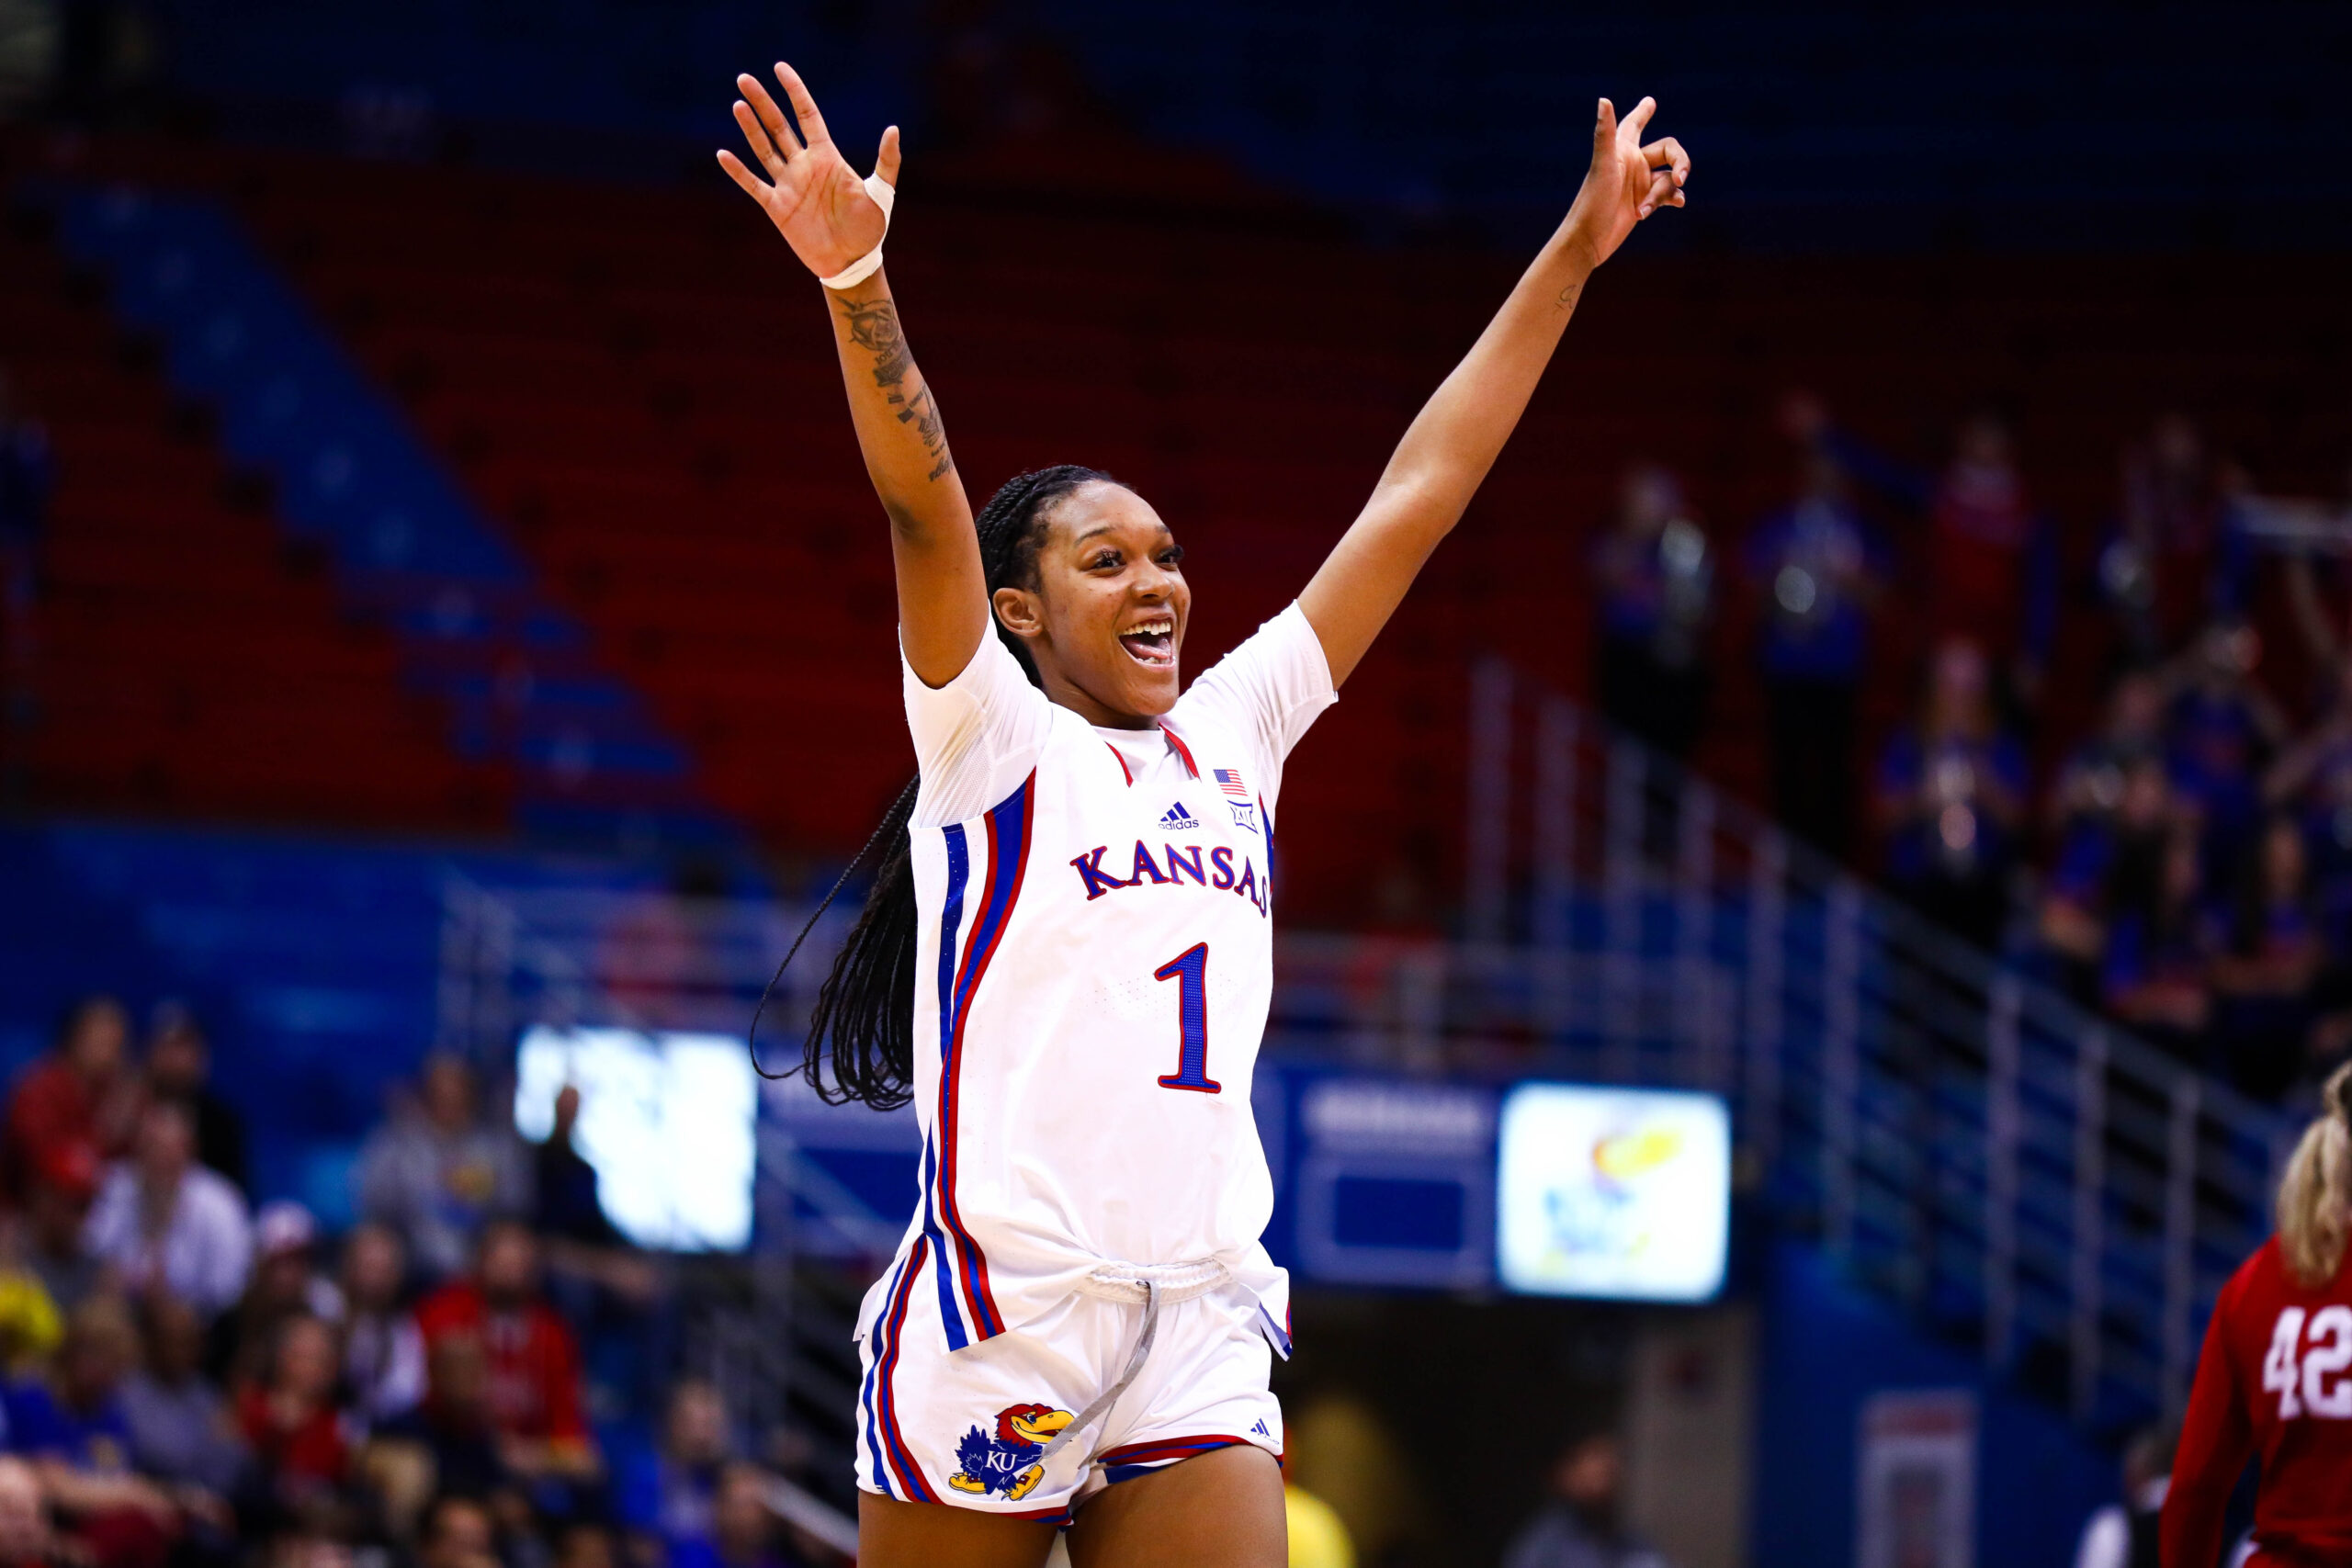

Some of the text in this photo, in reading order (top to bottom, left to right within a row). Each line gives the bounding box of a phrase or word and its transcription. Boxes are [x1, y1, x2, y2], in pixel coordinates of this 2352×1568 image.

[1158, 818, 1200, 830] adidas
[1069, 840, 1268, 919] KANSAS
[1154, 942, 1222, 1094] 1
[2262, 1303, 2352, 1421] 42
[985, 1450, 1018, 1473] KU
